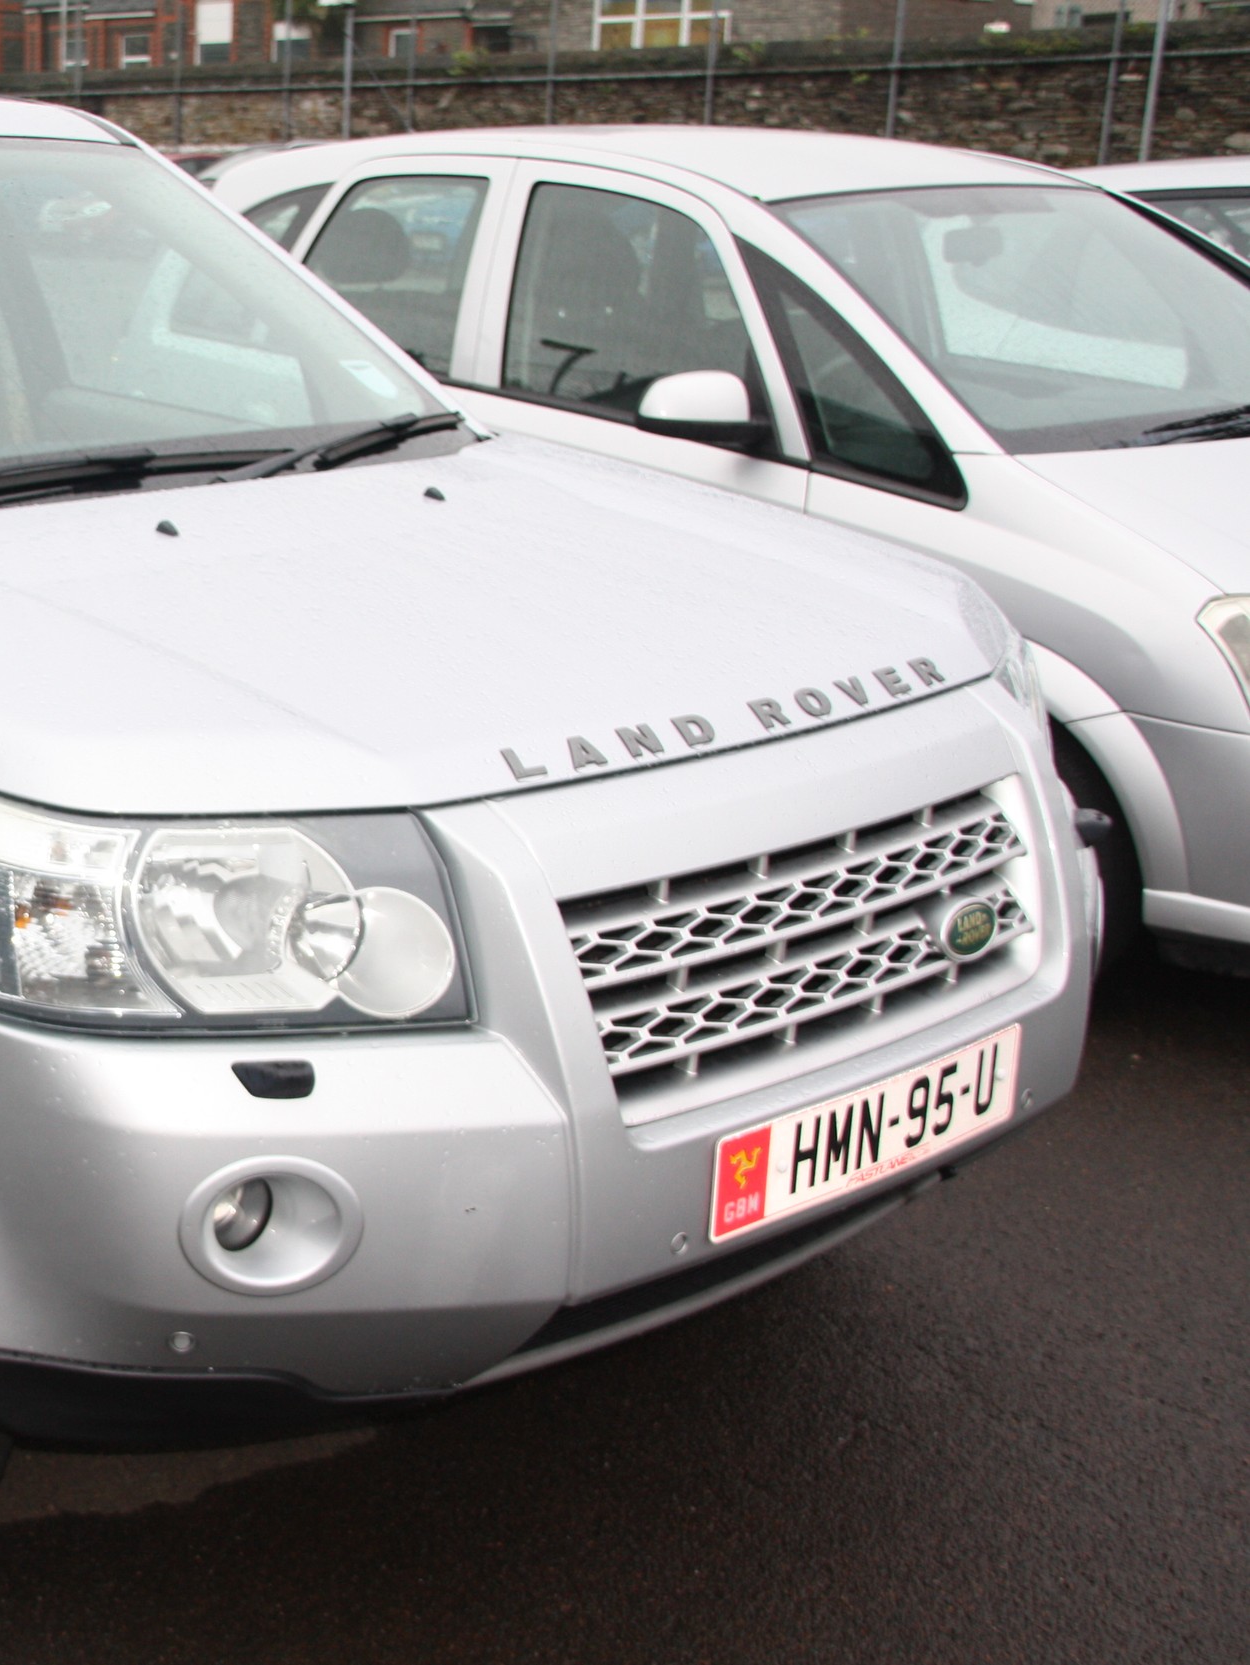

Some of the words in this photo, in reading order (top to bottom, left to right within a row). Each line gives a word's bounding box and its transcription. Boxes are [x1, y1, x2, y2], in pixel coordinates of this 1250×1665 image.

[499, 713, 716, 782] LAND
[746, 656, 946, 730] ROVER
[956, 911, 988, 932] LAND
[789, 1043, 998, 1195] HMN-95-U
[723, 1191, 760, 1224] GBM
